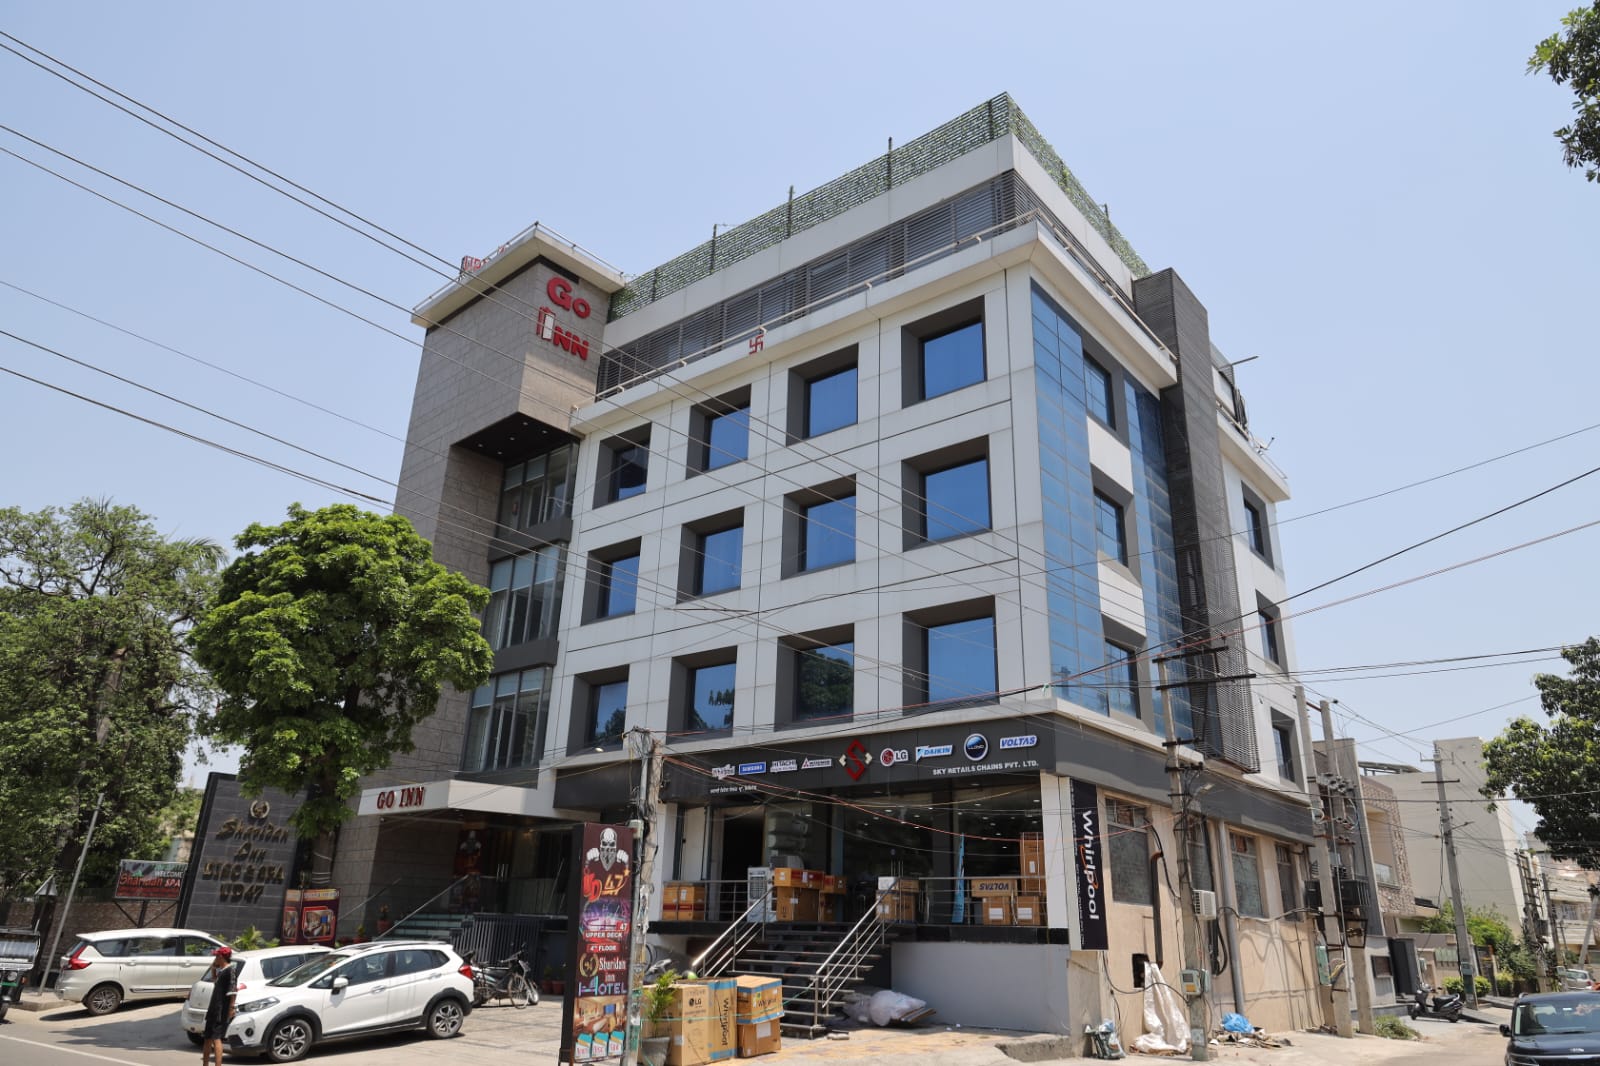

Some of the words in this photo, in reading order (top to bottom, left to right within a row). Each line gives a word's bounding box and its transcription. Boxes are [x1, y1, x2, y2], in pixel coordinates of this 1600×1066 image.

[1001, 735, 1036, 748] VOLTAS
[895, 751, 907, 761] LG
[932, 768, 946, 776] SKY
[977, 762, 1003, 772] CHAINS
[1004, 760, 1021, 769] PVT.
[1022, 759, 1040, 768] LTD.
[376, 790, 396, 810] GO
[399, 786, 425, 807] INN
[1082, 810, 1100, 920] Whirlpool
[585, 931, 606, 939] UPPER
